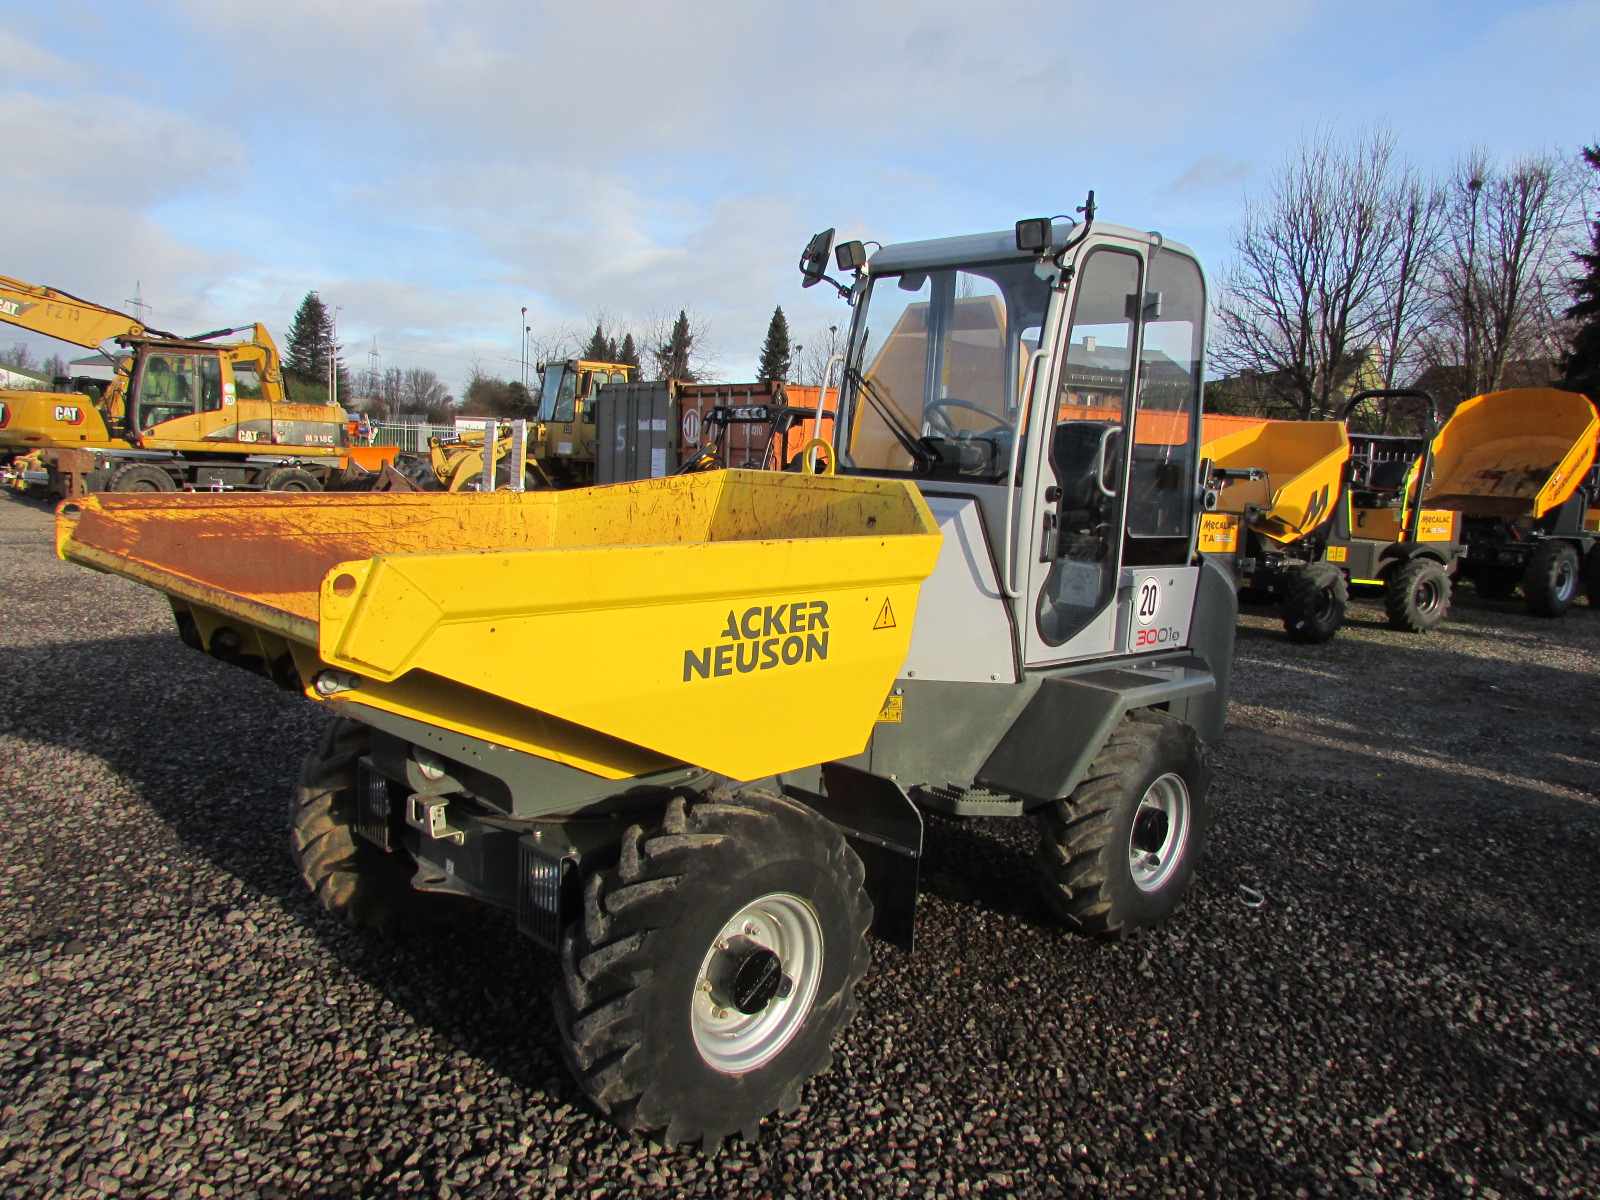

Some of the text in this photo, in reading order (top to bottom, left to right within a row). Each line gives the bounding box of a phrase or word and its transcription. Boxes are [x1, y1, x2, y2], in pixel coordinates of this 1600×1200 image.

[55, 406, 78, 421] CAT
[238, 430, 259, 442] CAT
[1140, 584, 1157, 616] 20
[682, 631, 830, 682] NEUSON
